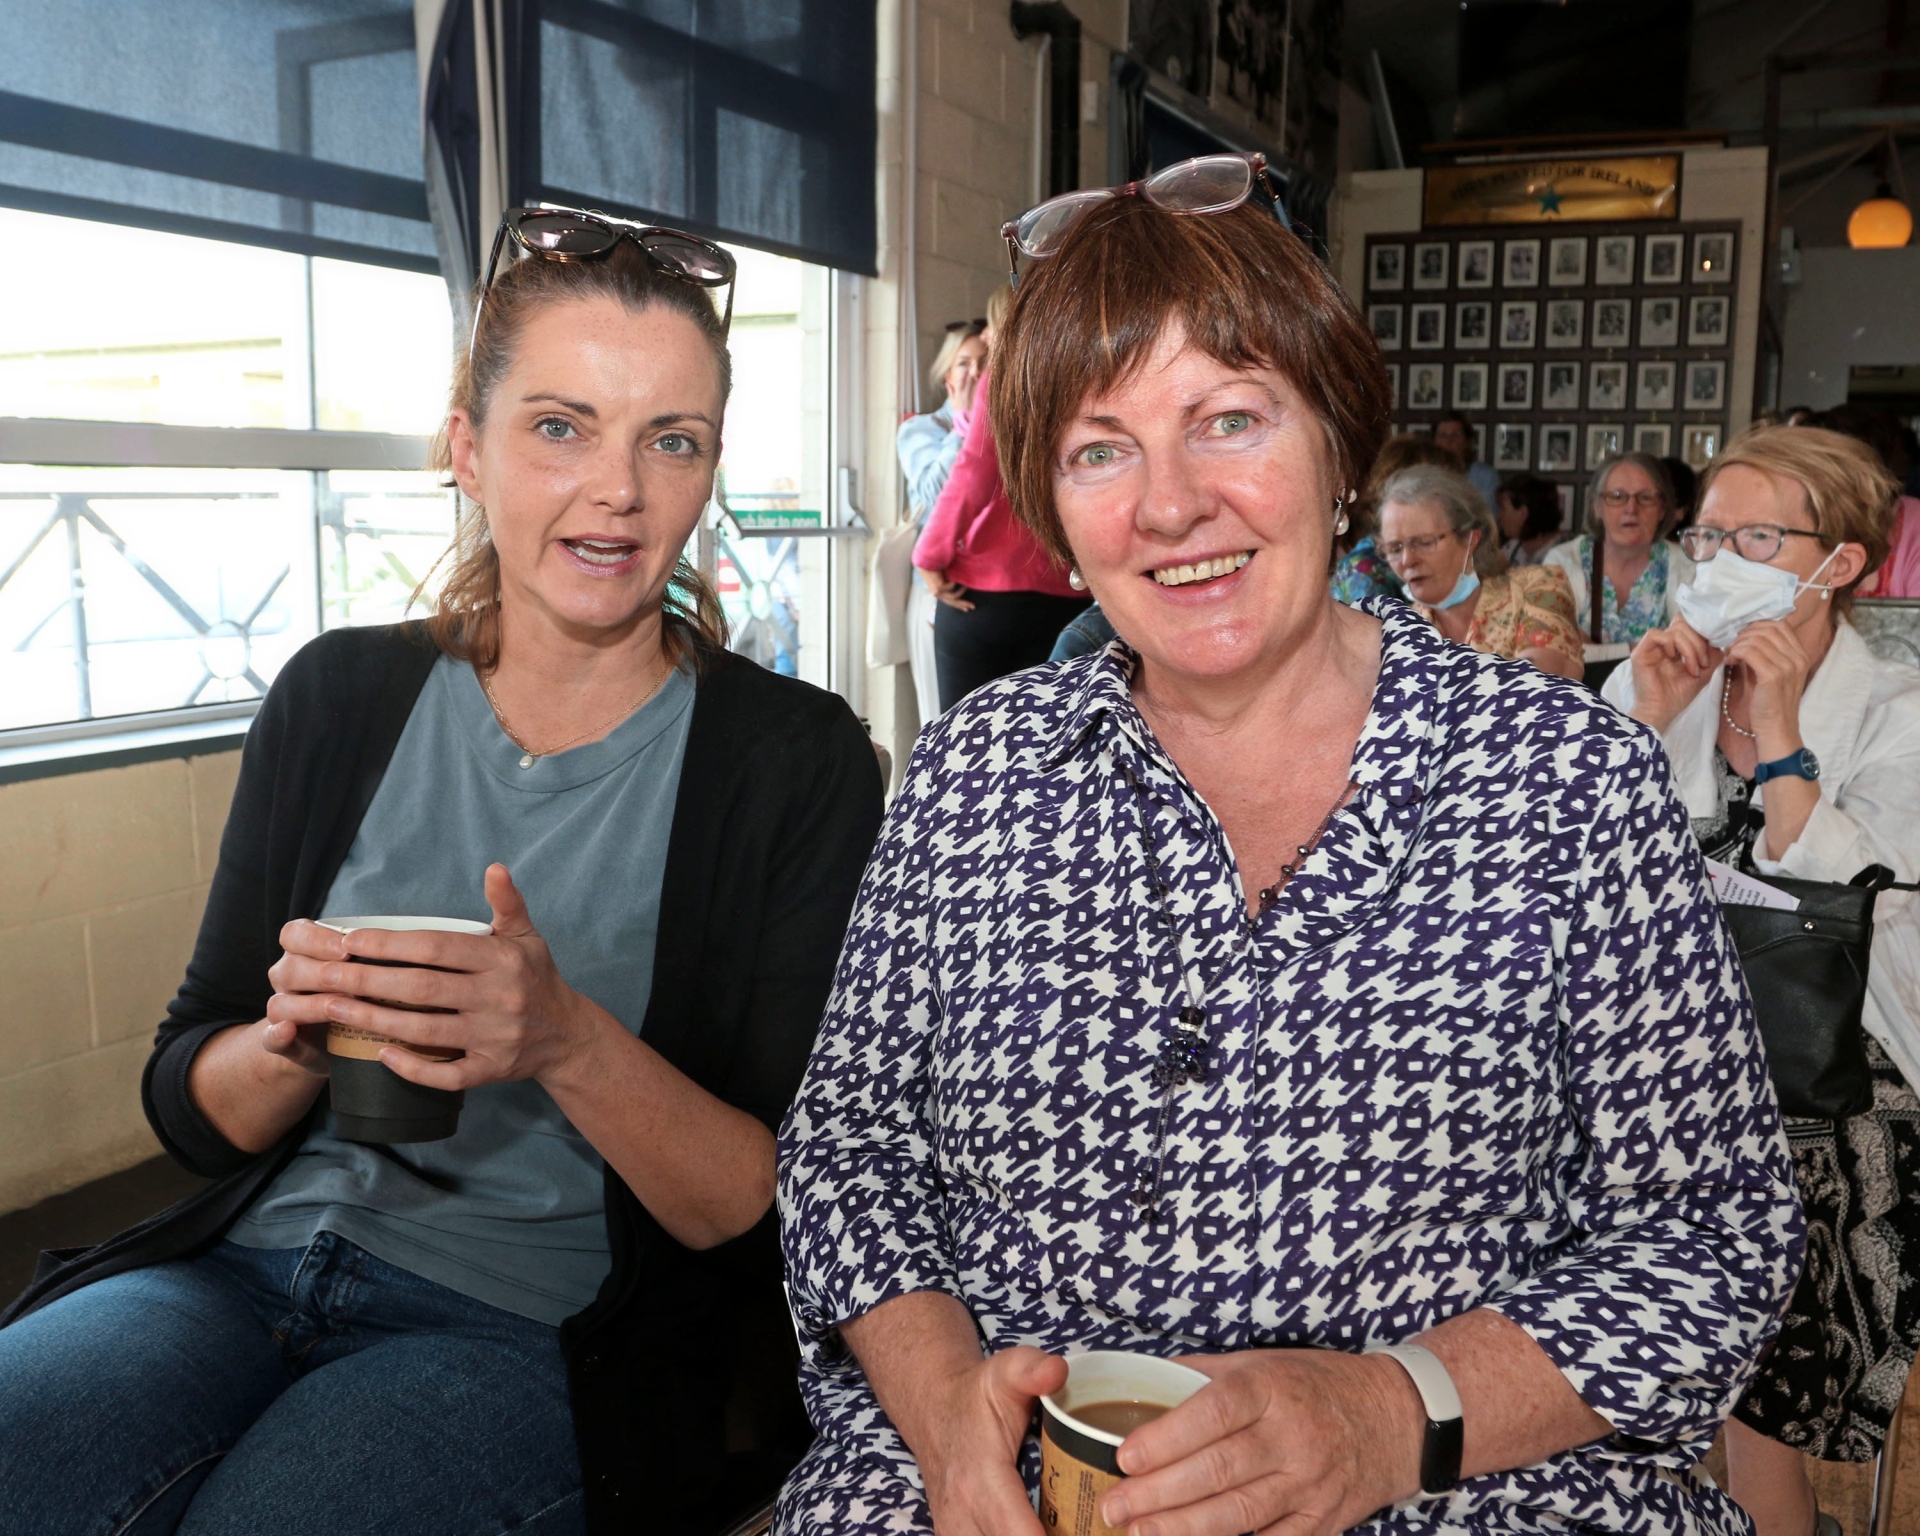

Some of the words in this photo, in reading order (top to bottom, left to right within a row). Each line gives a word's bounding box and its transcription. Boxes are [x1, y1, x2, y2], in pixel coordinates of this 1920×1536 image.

[1557, 165, 1586, 177] FOR
[1590, 166, 1656, 197] IRELAND
[1721, 876, 1733, 896] based
[1729, 882, 1739, 899] rural
